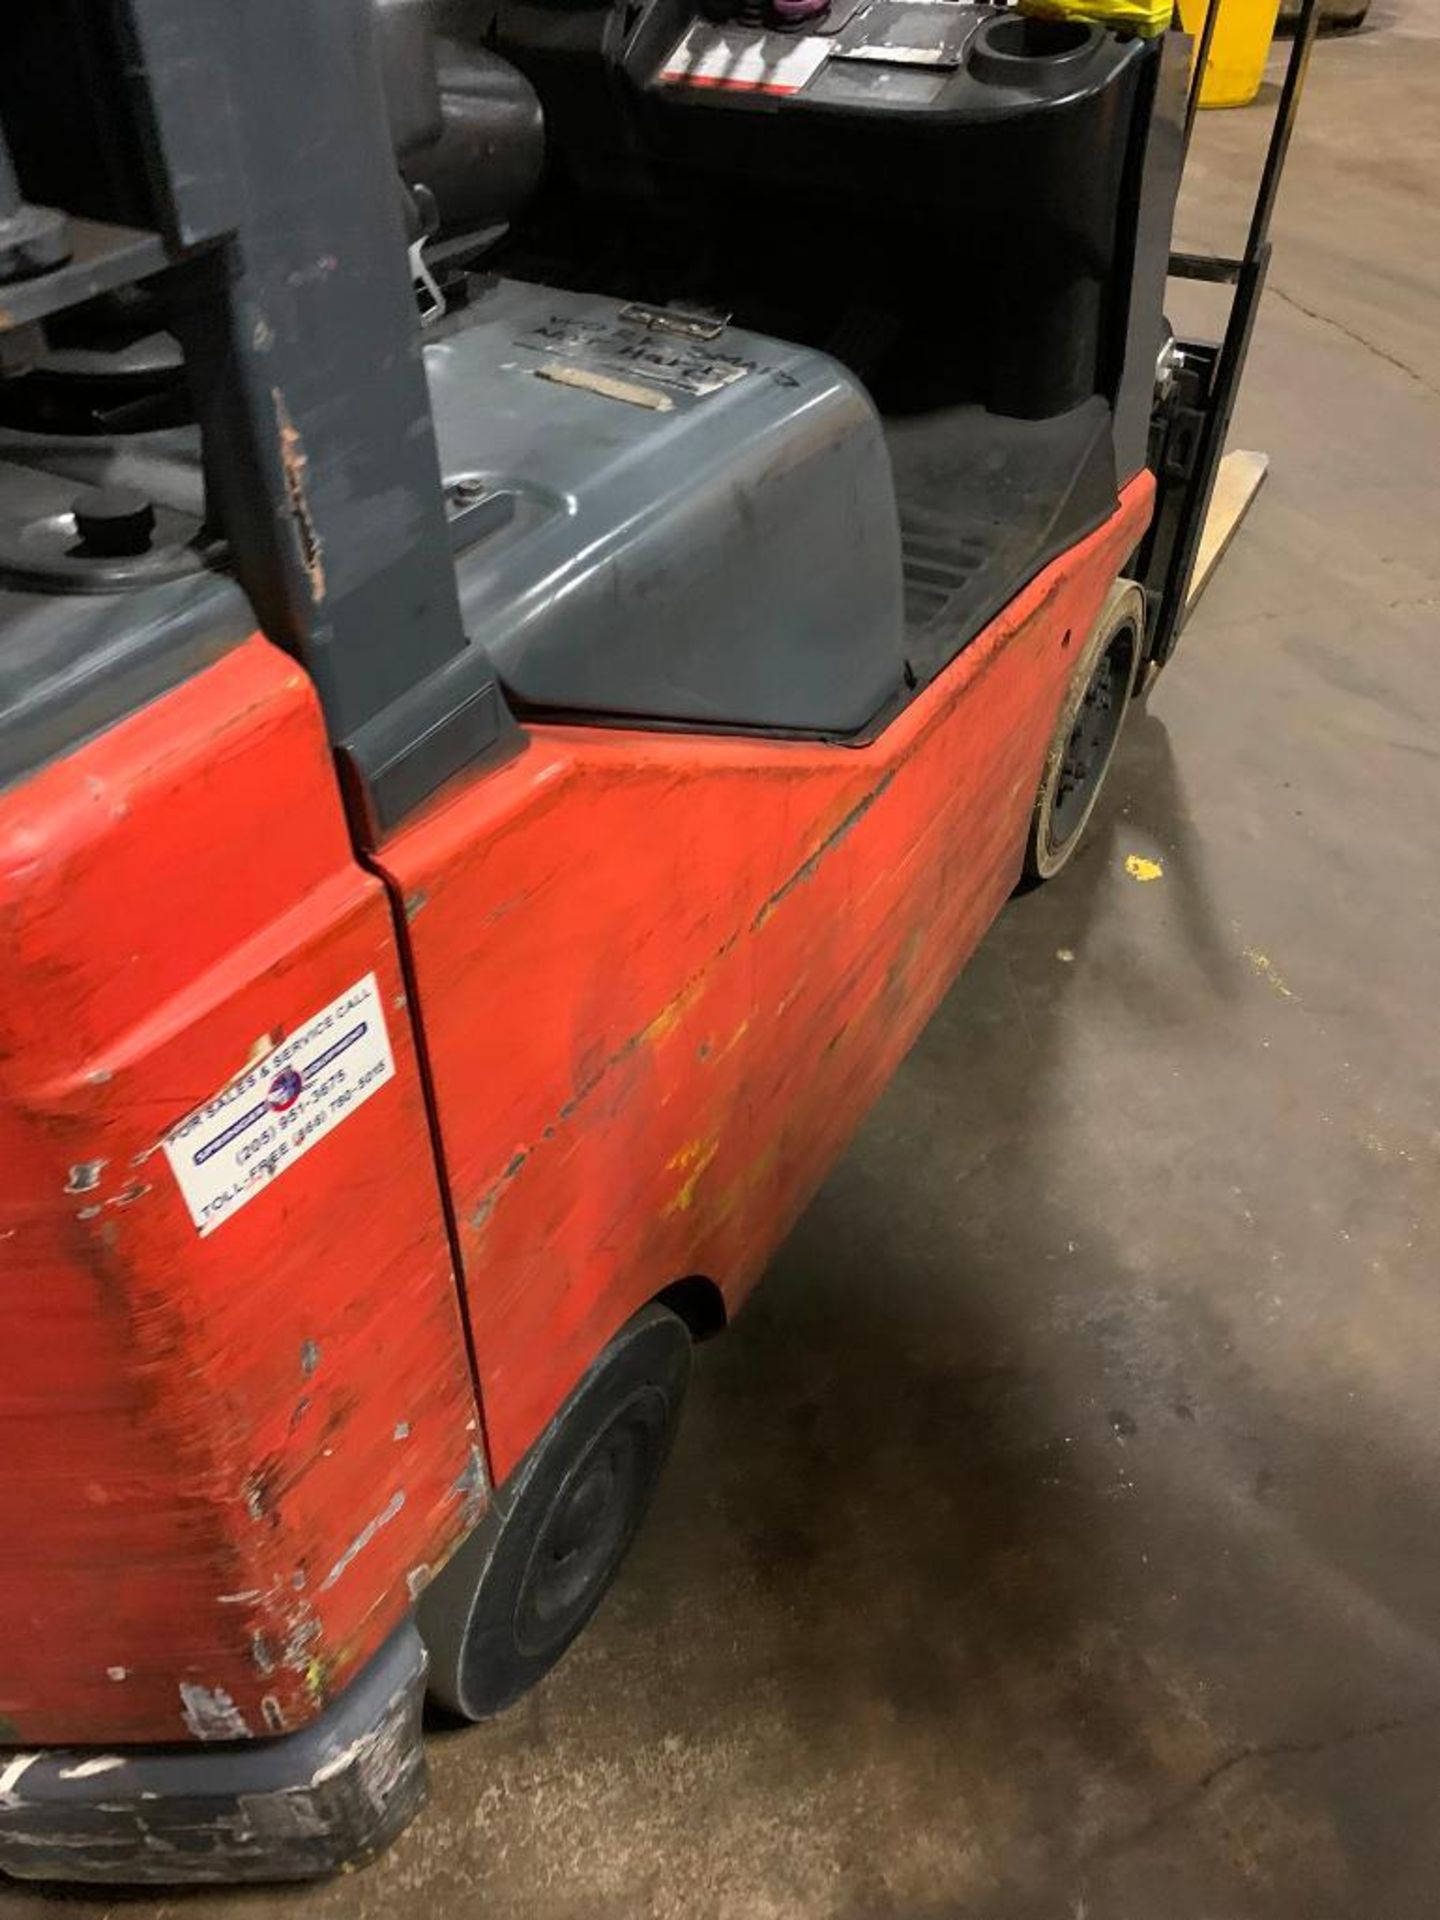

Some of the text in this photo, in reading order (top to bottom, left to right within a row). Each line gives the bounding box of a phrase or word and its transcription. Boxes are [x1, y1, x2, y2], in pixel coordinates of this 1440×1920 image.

[167, 1114, 203, 1147] FOR
[206, 1077, 257, 1121] SALES
[260, 1066, 271, 1080] &
[273, 1015, 334, 1069] SERVICE
[335, 988, 372, 1019] CALL
[201, 1140, 289, 1220] TOLL-FREE
[235, 1122, 277, 1168] (205)
